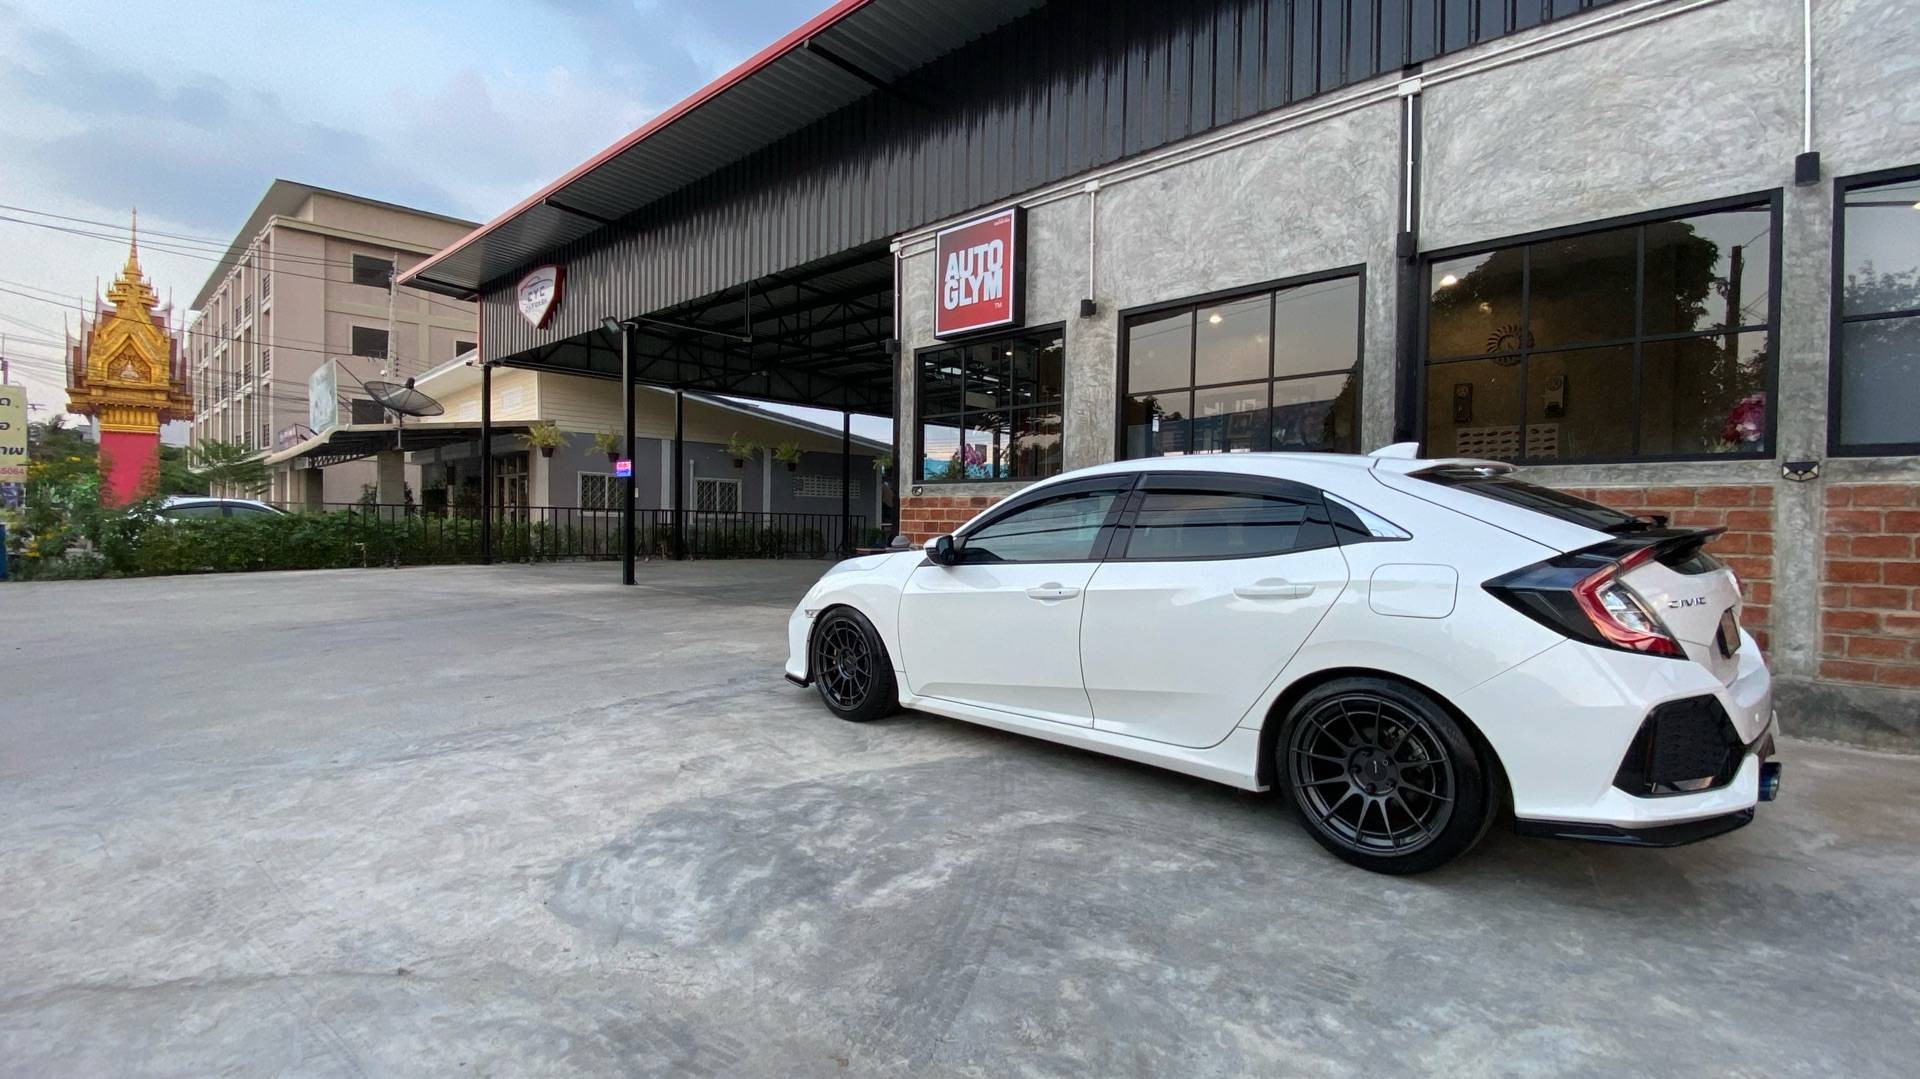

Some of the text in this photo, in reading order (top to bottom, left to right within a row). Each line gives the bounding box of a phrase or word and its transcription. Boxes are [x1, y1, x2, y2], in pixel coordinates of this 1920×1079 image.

[944, 239, 1003, 283] AUTO
[944, 268, 1003, 310] GLYM
[1668, 597, 1706, 609] CIVIC
